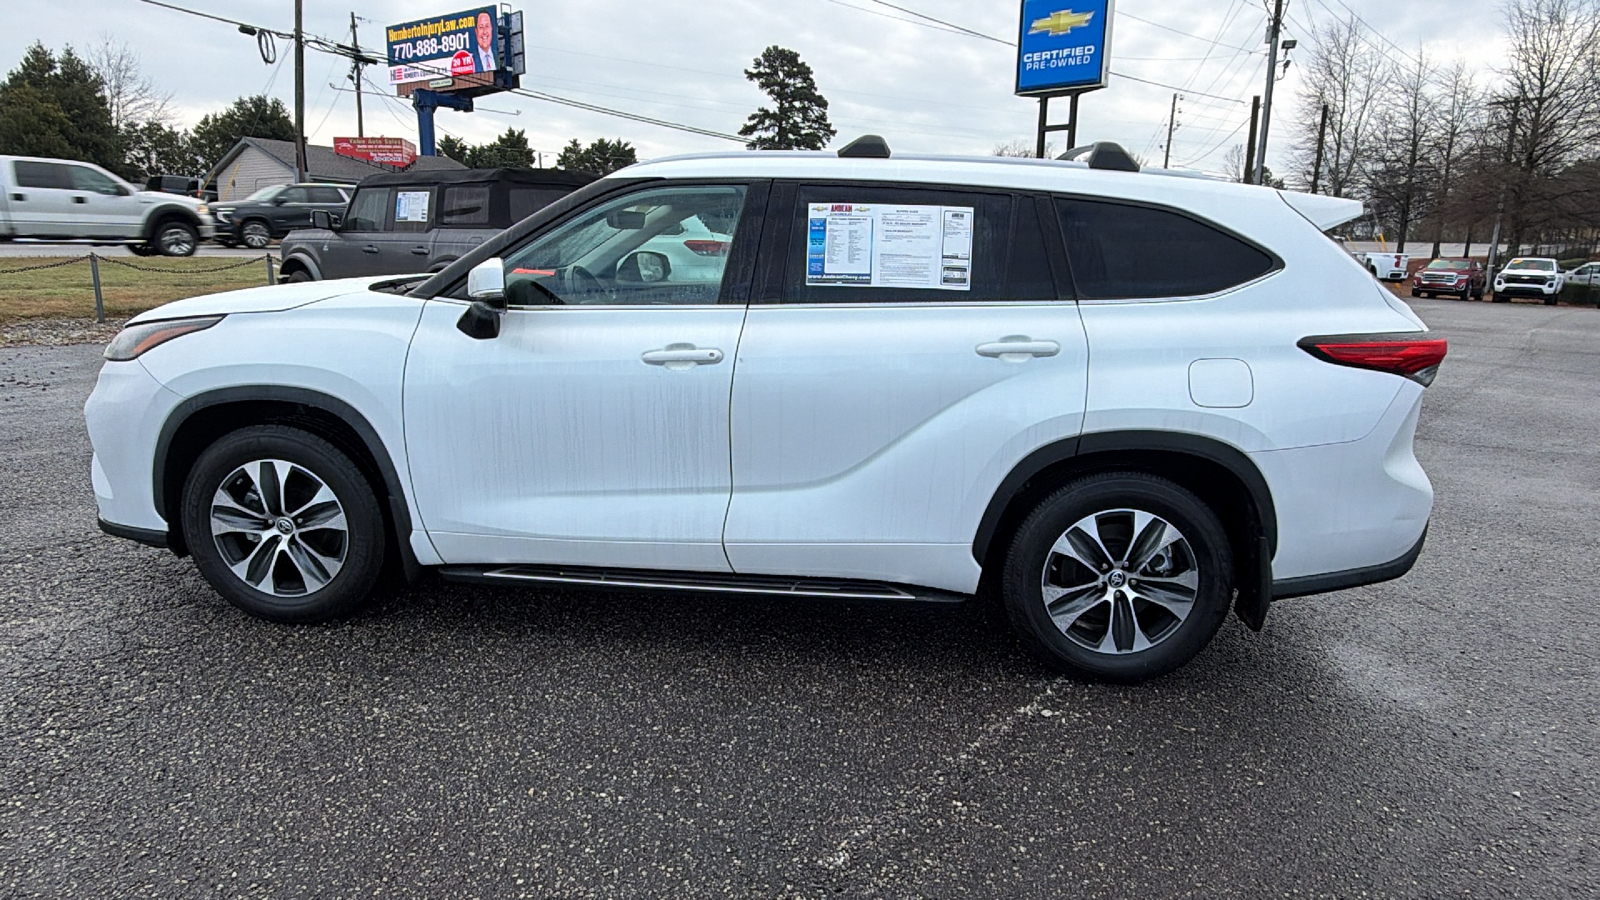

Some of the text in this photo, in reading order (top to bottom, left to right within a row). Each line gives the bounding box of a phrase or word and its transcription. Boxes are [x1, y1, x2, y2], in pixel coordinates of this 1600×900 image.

[388, 16, 476, 42] HumbertoInjuryLaw.com
[392, 32, 470, 60] 770-888-8901
[1023, 45, 1095, 63] CERTIFIED
[1026, 55, 1091, 71] PRE-OWNED
